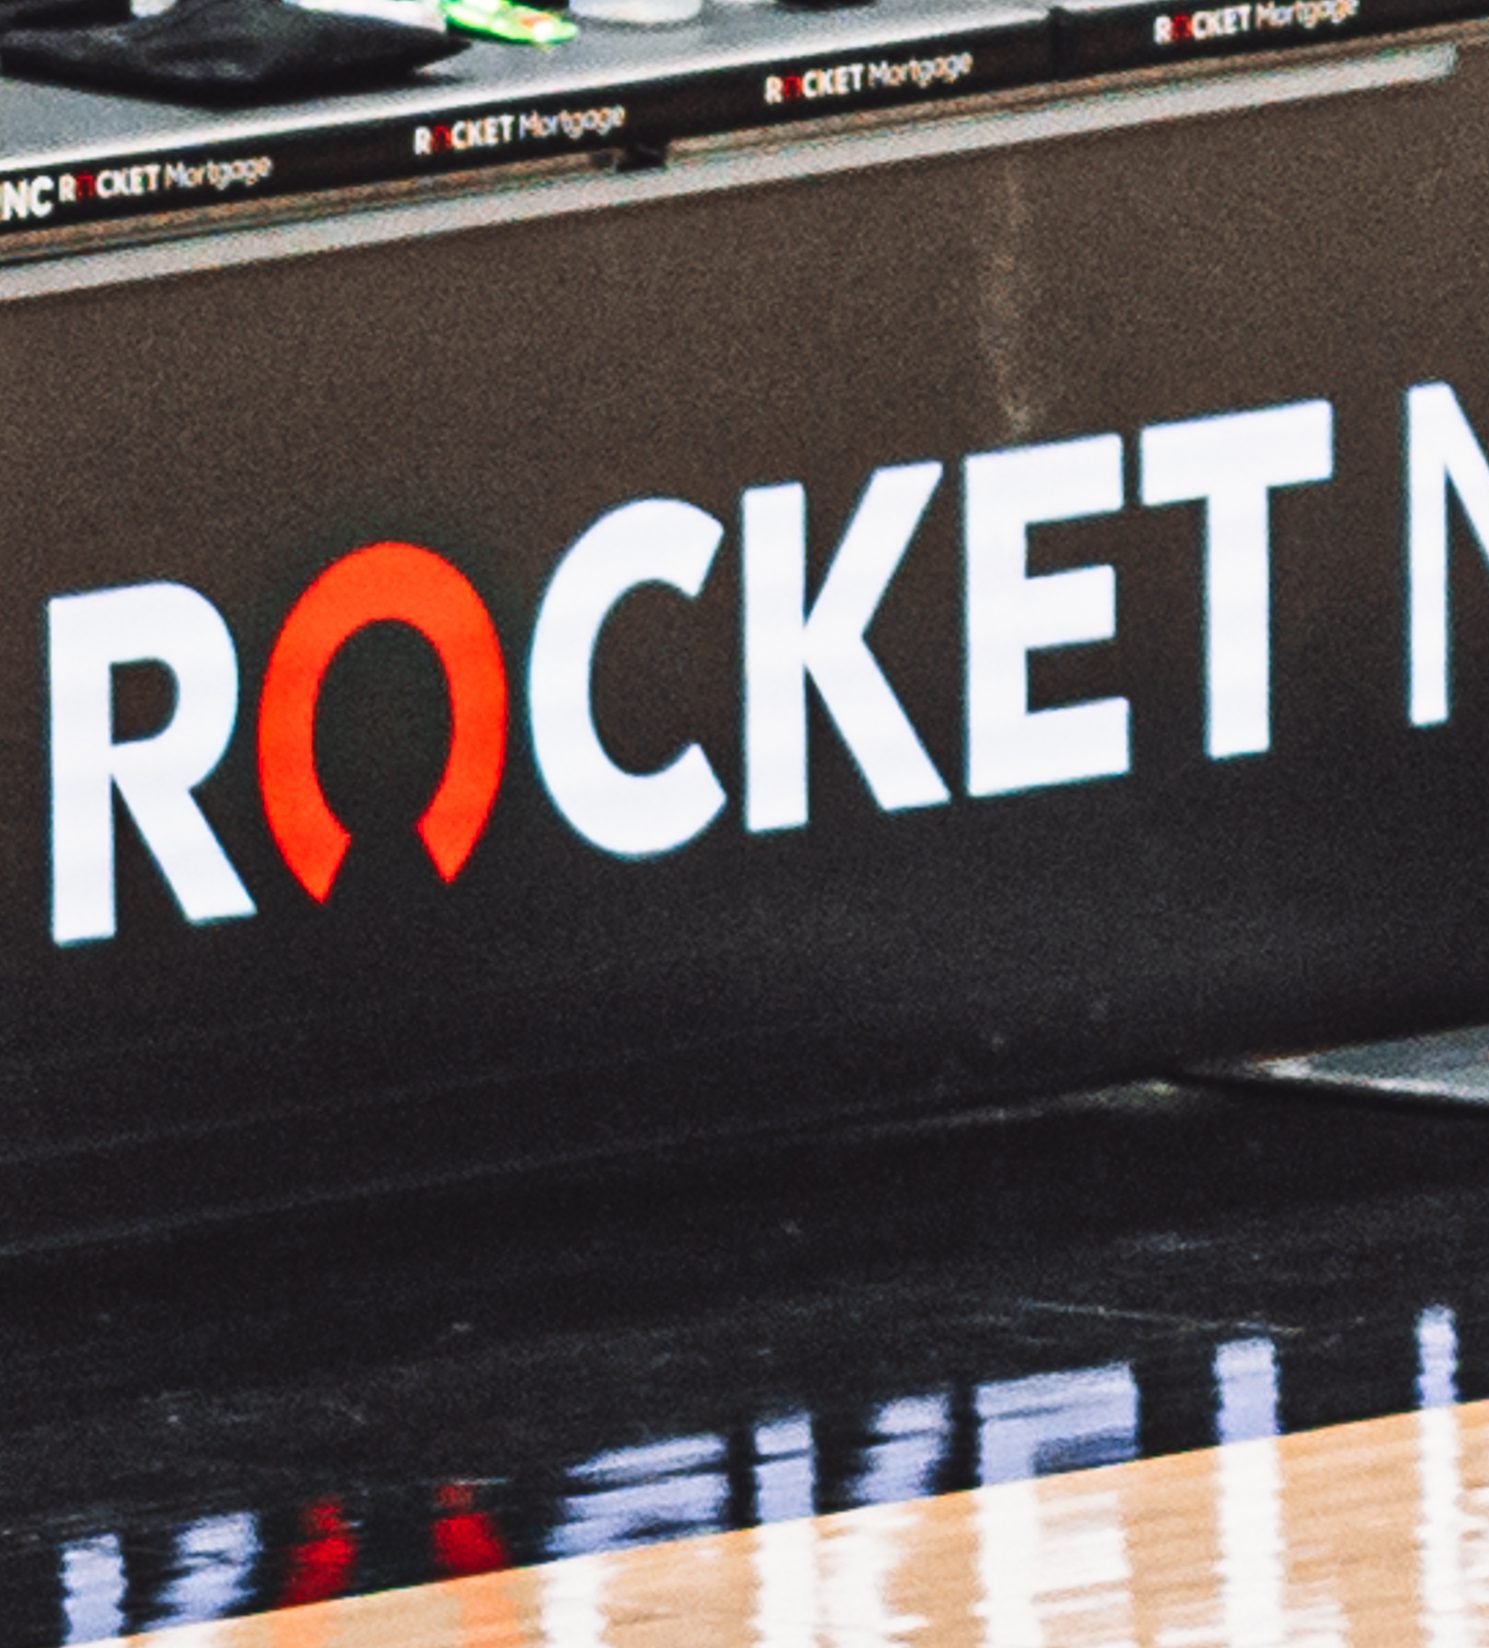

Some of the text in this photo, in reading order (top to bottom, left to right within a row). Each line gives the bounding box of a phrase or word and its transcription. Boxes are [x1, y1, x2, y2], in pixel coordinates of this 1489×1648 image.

[1153, 3, 1251, 45] ROCKET
[764, 52, 974, 105] ROCKET Mortgage
[414, 104, 626, 156] ROCKET Mortgage
[58, 163, 160, 203] ROCKET
[164, 156, 273, 191] Mortgage
[46, 398, 1335, 948] ROCKET
